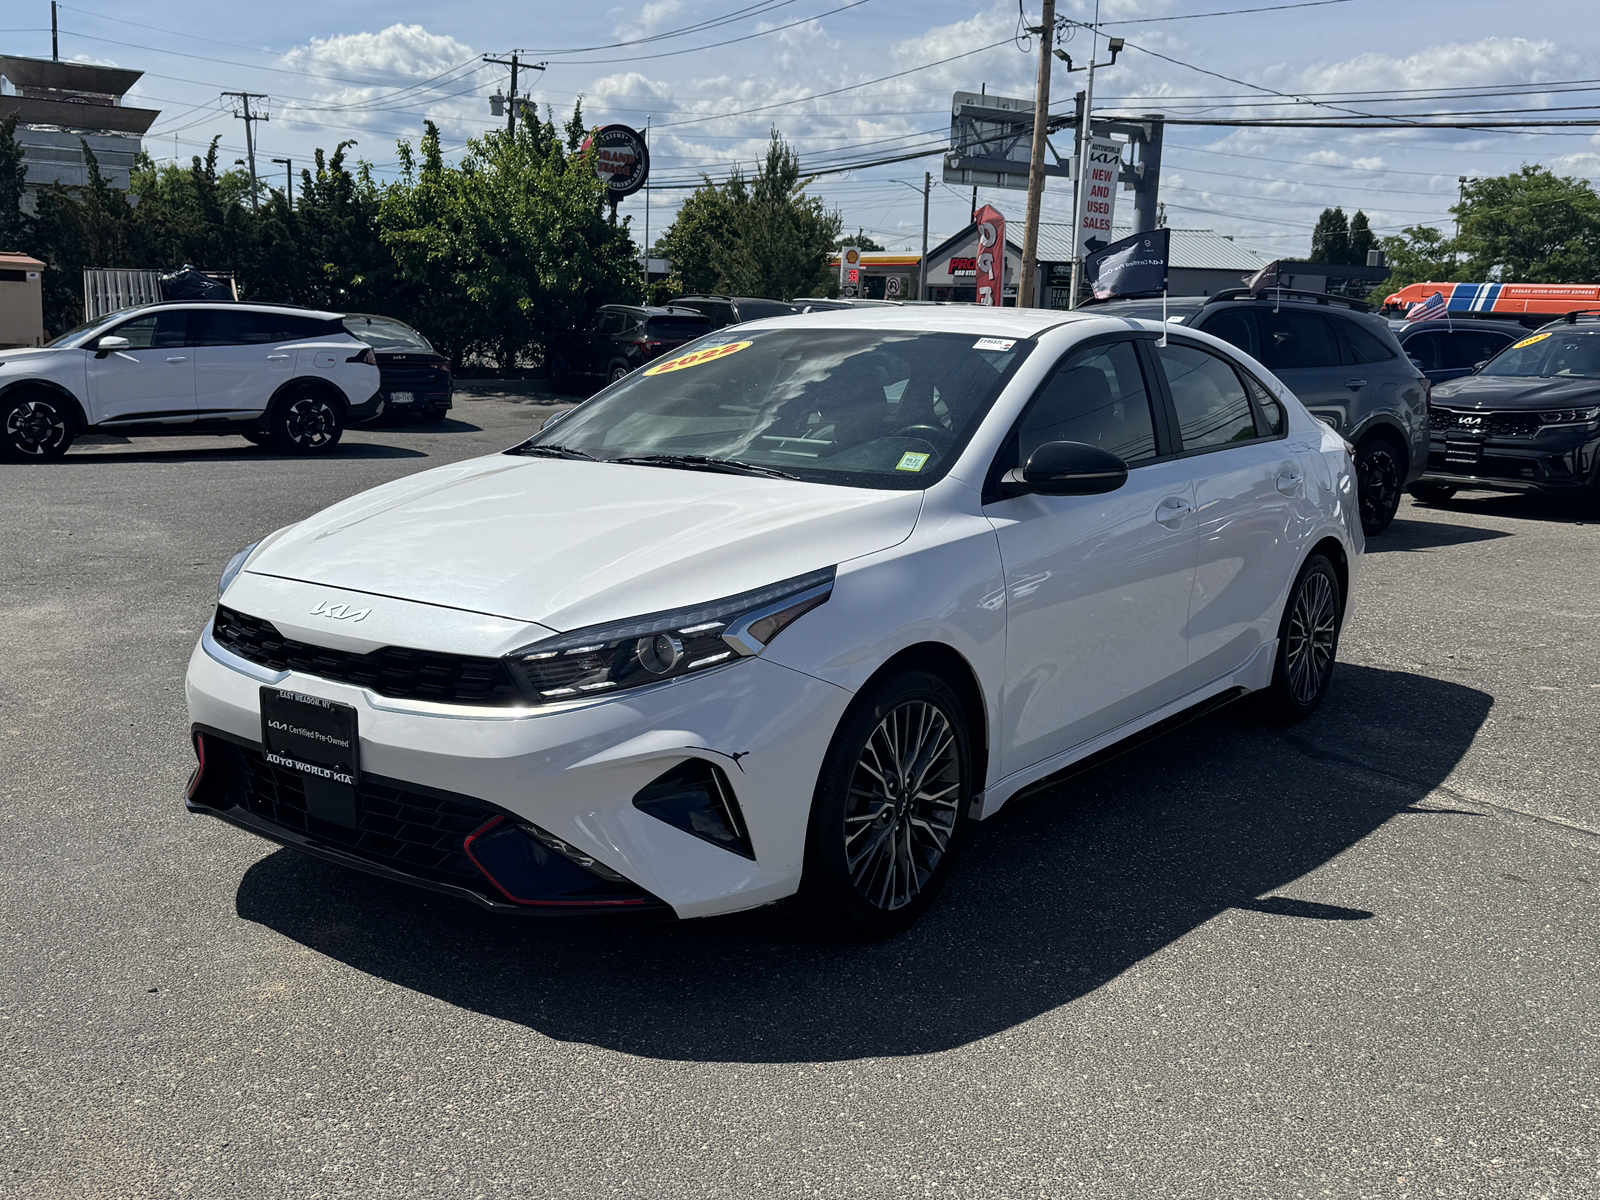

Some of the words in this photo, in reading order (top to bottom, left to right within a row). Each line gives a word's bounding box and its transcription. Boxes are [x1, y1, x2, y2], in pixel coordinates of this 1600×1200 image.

[1092, 143, 1120, 154] AUTOWORLD
[1090, 152, 1119, 165] KIA
[1092, 168, 1113, 182] NEW
[1090, 185, 1110, 198] AND
[1087, 201, 1110, 215] USED
[1083, 216, 1110, 231] SALES
[656, 343, 741, 374] 2022
[1458, 416, 1482, 425] KIA
[310, 600, 373, 622] KIA
[280, 690, 294, 700] EAST
[322, 700, 331, 709] NY
[268, 719, 287, 731] KIA
[289, 724, 315, 739] Certified
[315, 731, 349, 748] Pre-Owned
[266, 753, 293, 767] AUTO
[295, 761, 331, 778] WORLD
[333, 772, 353, 785] KIA
